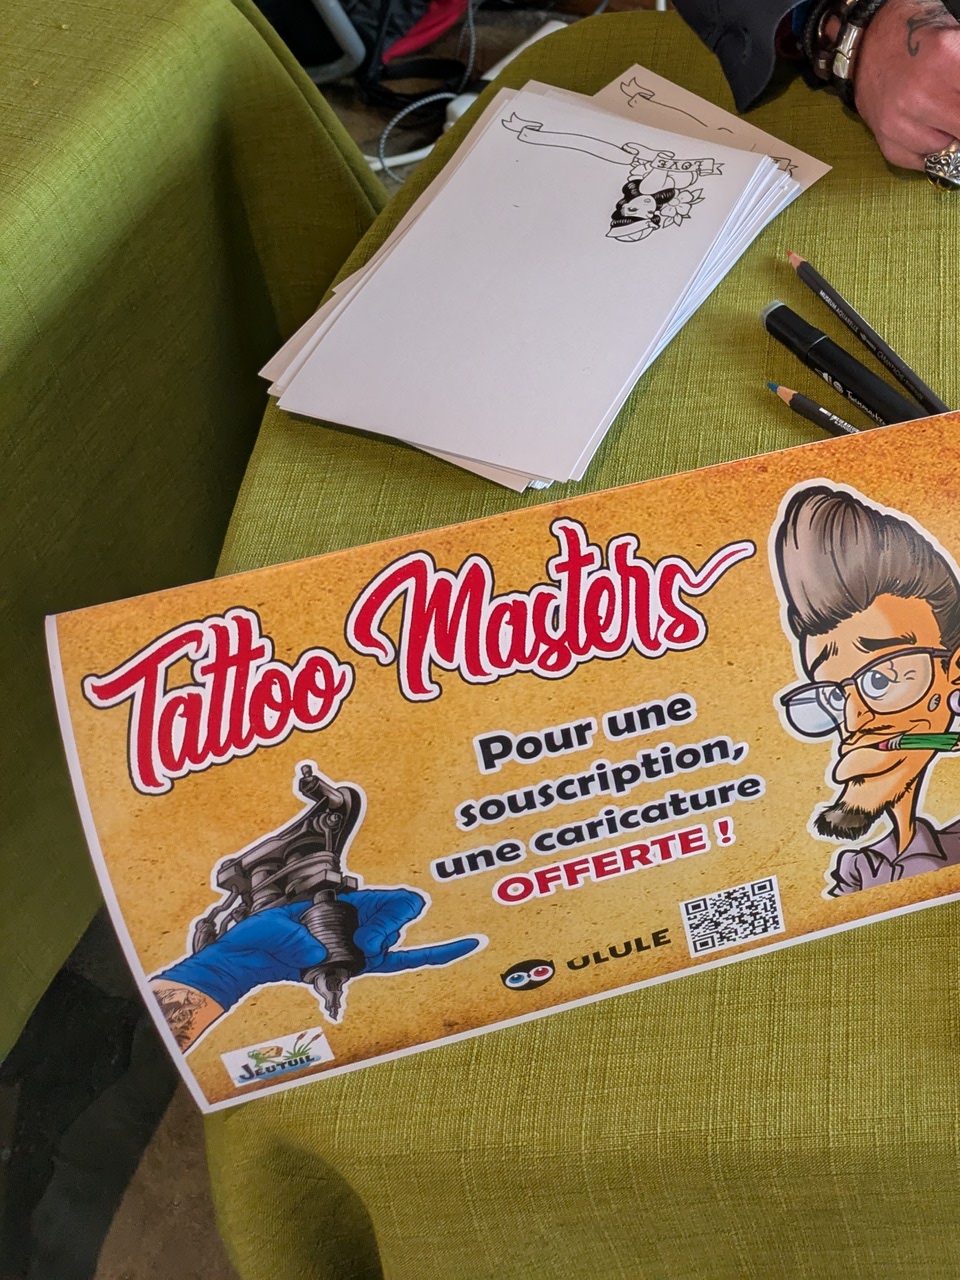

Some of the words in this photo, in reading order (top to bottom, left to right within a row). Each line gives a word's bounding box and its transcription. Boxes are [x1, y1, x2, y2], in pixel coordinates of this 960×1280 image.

[657, 157, 704, 171] LOVE
[819, 290, 837, 308] MUSEUM
[837, 307, 859, 332] AQUARELLE
[87, 611, 349, 793] Tattoo
[349, 522, 752, 698] Masters
[478, 721, 592, 770] Pour
[607, 697, 692, 736] une
[460, 738, 745, 827] souscription,
[436, 842, 521, 879] une
[534, 777, 761, 852] caricature
[497, 827, 707, 902] OFFERTE
[567, 928, 672, 971] ULULE
